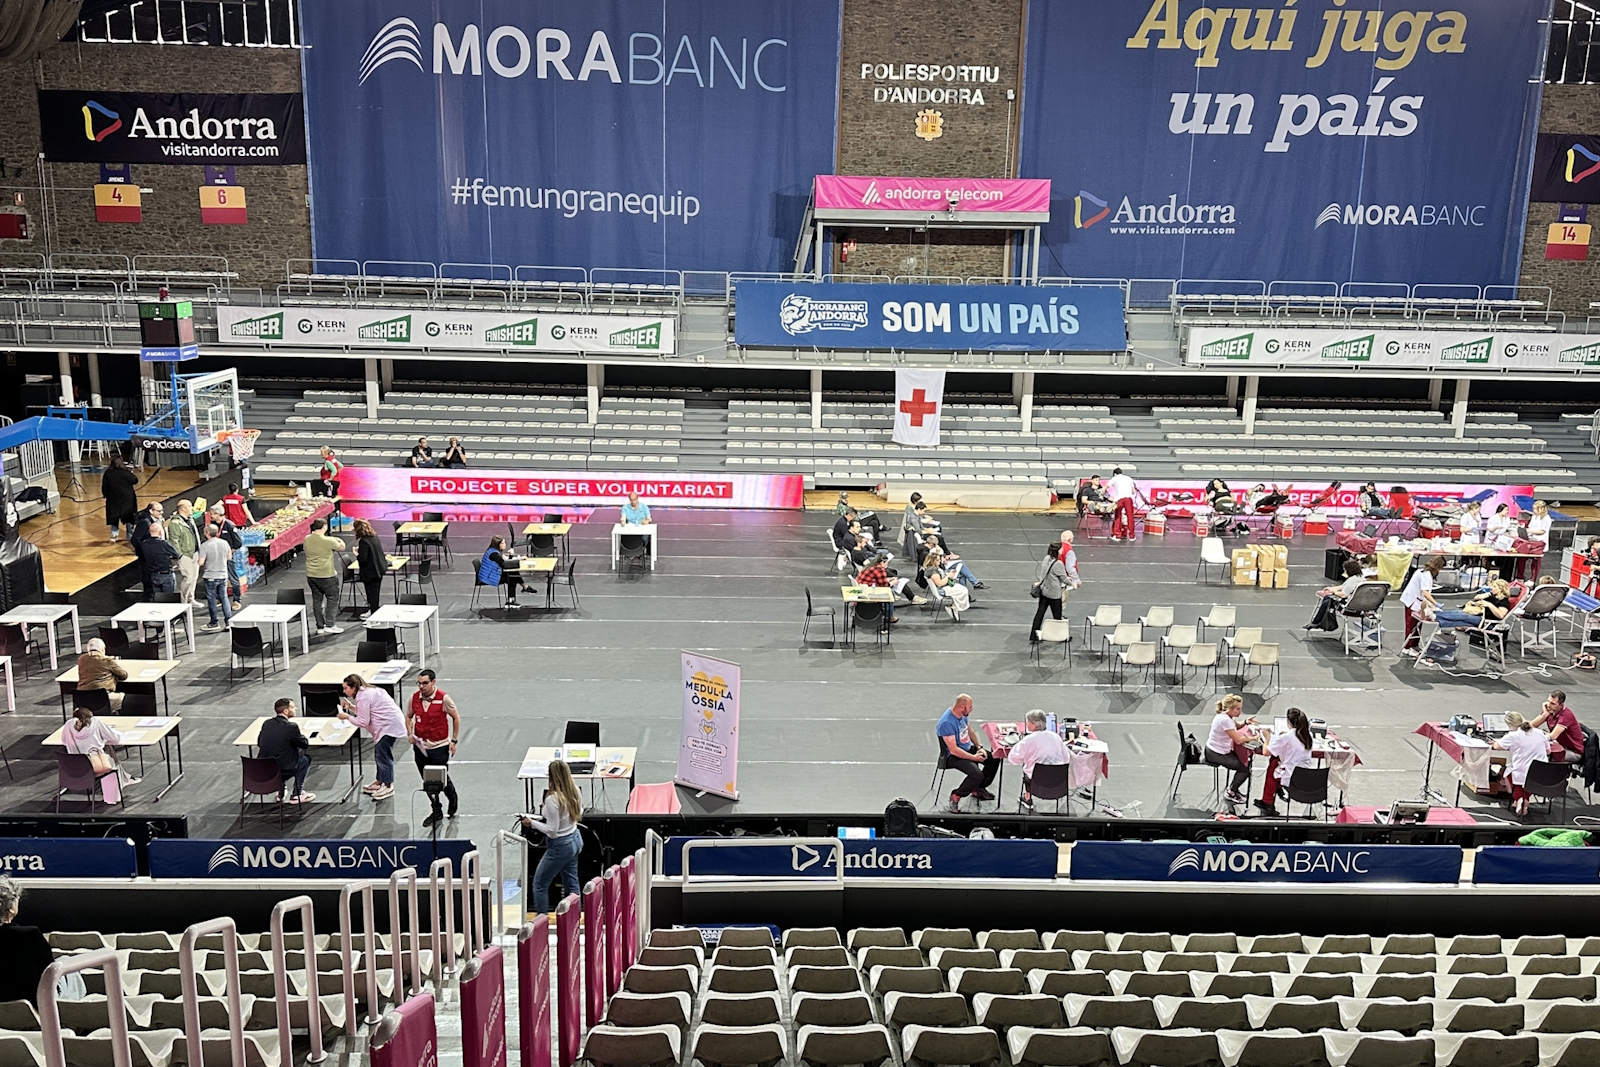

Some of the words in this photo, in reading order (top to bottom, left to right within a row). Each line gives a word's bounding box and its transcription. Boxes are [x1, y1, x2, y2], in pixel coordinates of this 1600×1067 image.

[1126, 0, 1298, 67] Aquí
[1306, 0, 1468, 70] juga
[433, 22, 787, 92] MORABANC
[861, 63, 1000, 83] POLIESPORTIU
[874, 87, 985, 106] D'ANDORRA
[128, 107, 277, 140] Andorra
[1168, 91, 1254, 135] un
[1264, 78, 1424, 152] país
[161, 142, 279, 157] visitandorra.com
[112, 187, 122, 203] 4
[217, 188, 227, 205] 6
[451, 177, 700, 224] #femungranequip
[885, 187, 941, 199] andorra
[945, 187, 1004, 200] telecom
[1110, 194, 1236, 224] Andorra
[1343, 204, 1486, 226] MORABANC
[1110, 226, 1236, 235] www.visitandorra.com
[1562, 226, 1576, 241] 14
[809, 303, 865, 311] MORABANC
[882, 300, 951, 333] SOM
[959, 302, 1002, 334] UN
[1009, 297, 1079, 335] PAÍS
[317, 320, 346, 328] KERN
[809, 311, 865, 323] ANDORRA
[231, 317, 281, 336] FINISHER
[359, 320, 409, 338] FINISHER
[445, 323, 473, 331] KERN
[486, 324, 535, 342] FINISHER
[570, 327, 598, 335] KERN
[611, 327, 658, 345] FINISHER
[1284, 340, 1311, 348] KERN
[1201, 338, 1249, 356] FINISHER
[1322, 340, 1369, 358] FINISHER
[1404, 342, 1431, 350] KERN
[1441, 342, 1488, 360] FINISHER
[1522, 344, 1550, 352] KERN
[143, 439, 190, 449] endesa
[417, 480, 518, 493] PROJECTE
[528, 479, 590, 495] SÚPER
[597, 482, 727, 496] VOLUNTARIAT
[691, 692, 725, 712] ÒSSIA
[243, 845, 419, 869] MORABANC
[823, 846, 933, 870] Andorra
[1202, 848, 1371, 874] MORABANC
